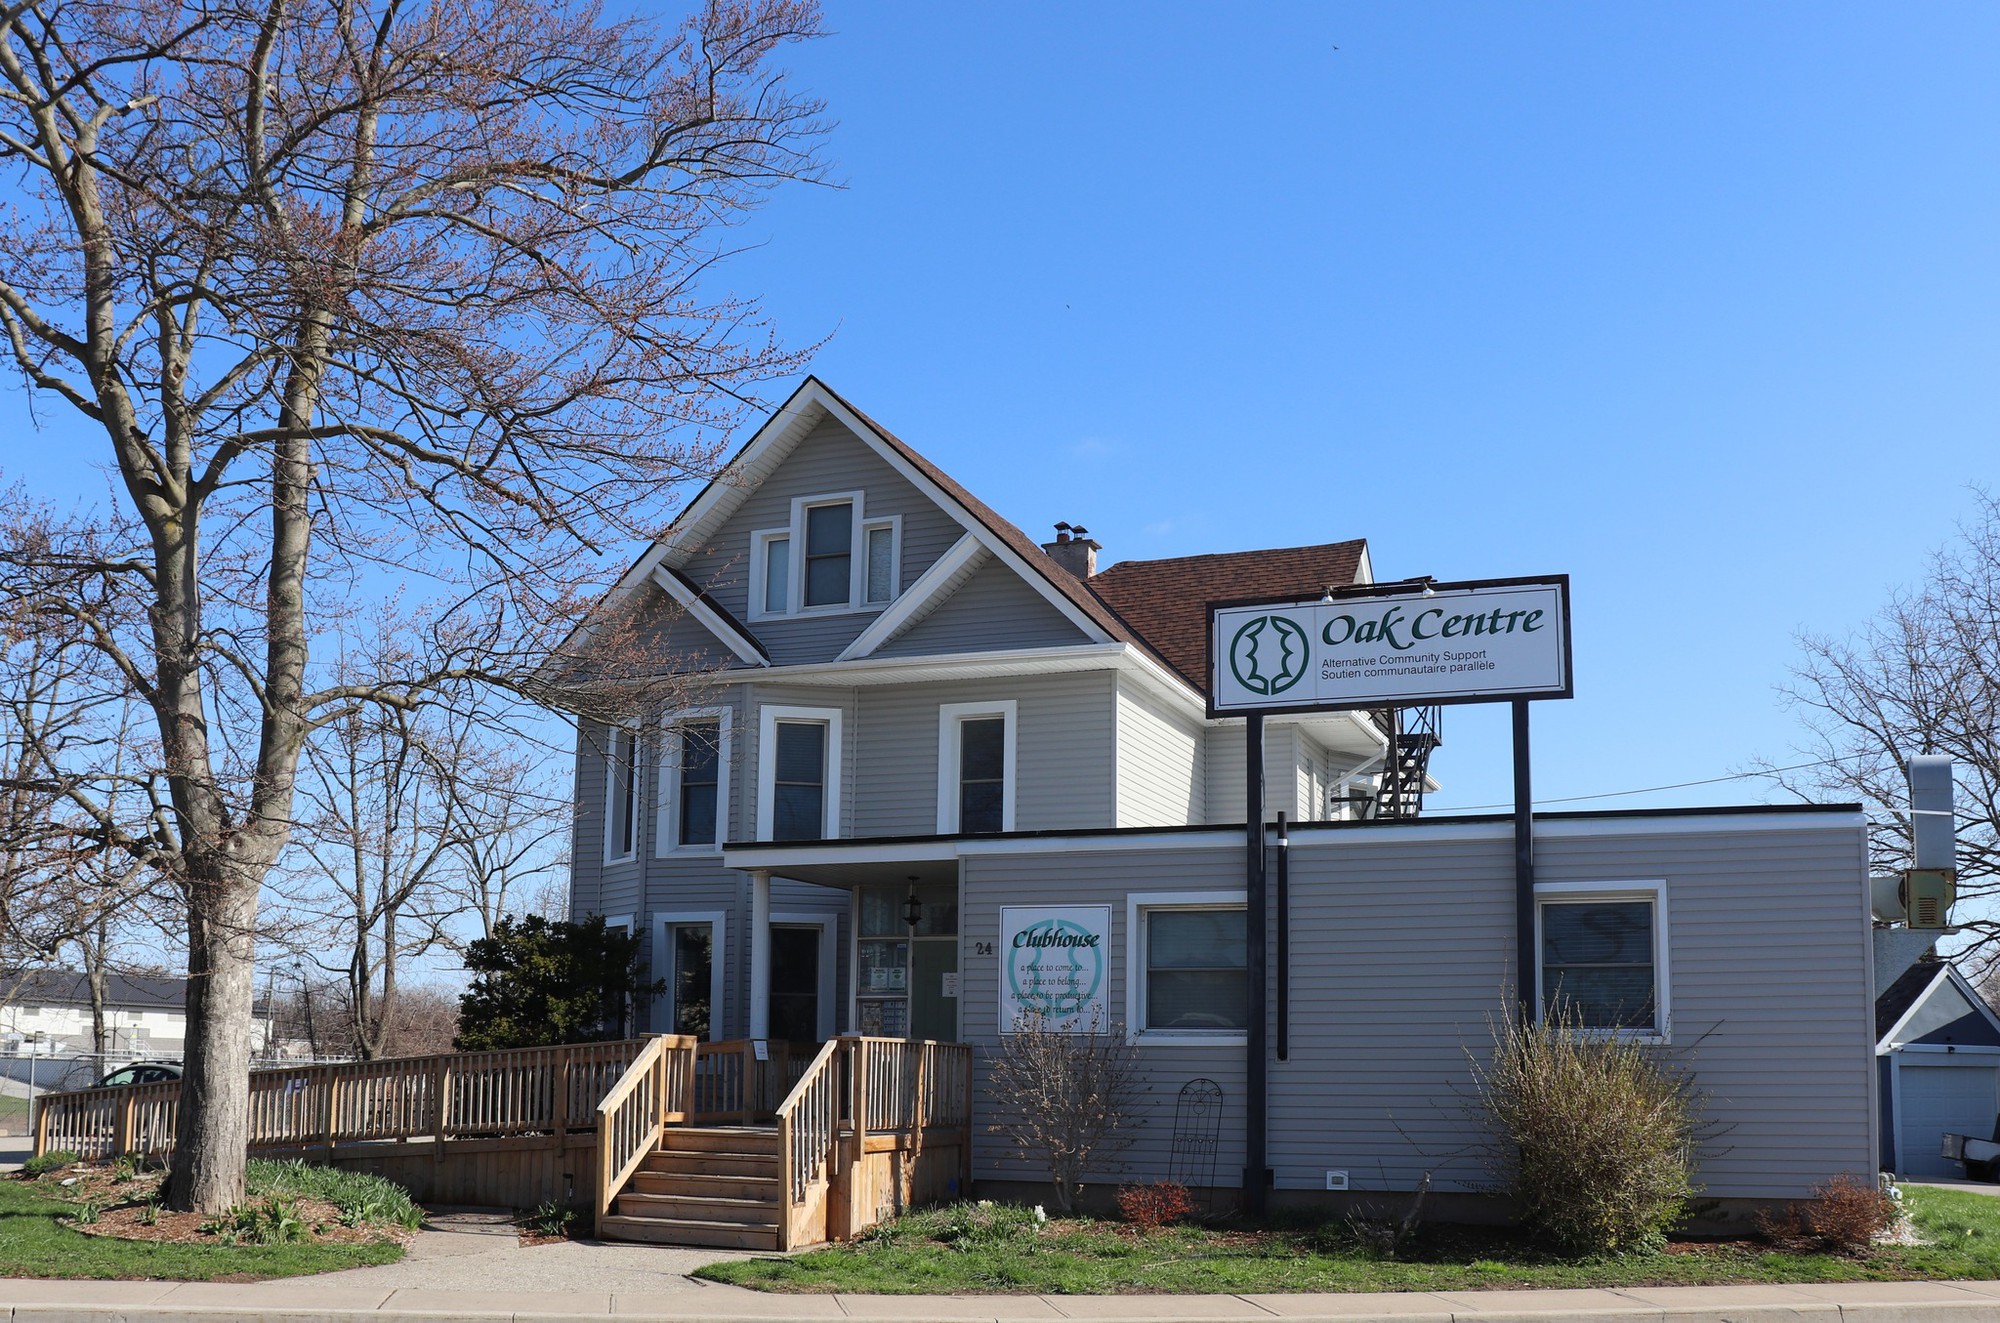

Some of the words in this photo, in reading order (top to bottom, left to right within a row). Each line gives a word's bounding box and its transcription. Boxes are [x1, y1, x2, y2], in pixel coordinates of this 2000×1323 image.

[1322, 606, 1415, 650] Oak
[1411, 607, 1545, 640] Centre
[1322, 656, 1377, 669] Alternative
[1379, 652, 1441, 666] Community
[1443, 649, 1487, 663] Support
[1321, 668, 1361, 680] Soutien
[1364, 663, 1447, 677] communautaire
[1450, 660, 1496, 674] parallèle
[1012, 928, 1100, 949] Clubhouse
[975, 941, 993, 955] 24
[1026, 962, 1044, 975] place
[1046, 963, 1054, 972] to
[1029, 976, 1046, 989] place
[1048, 978, 1056, 986] to
[1017, 989, 1034, 1002] place
[1046, 990, 1053, 999] be
